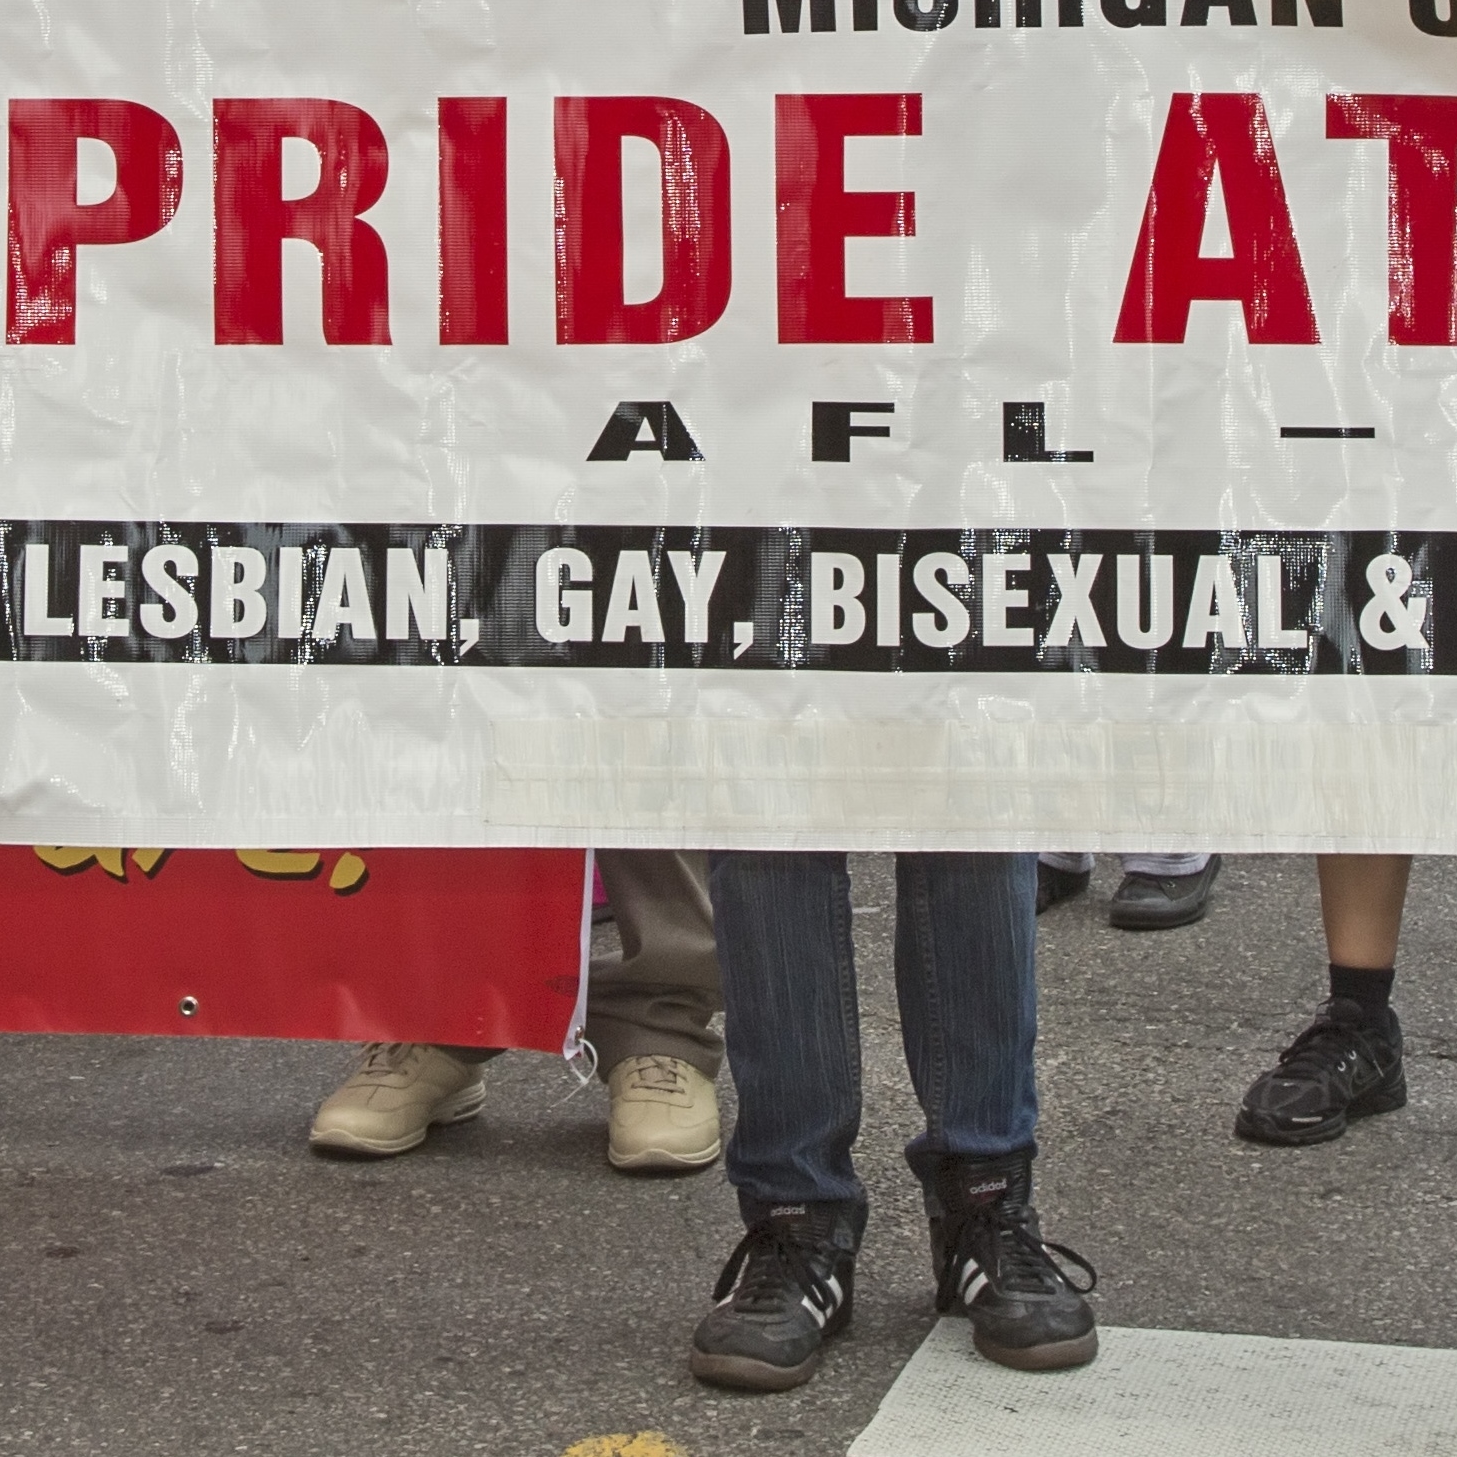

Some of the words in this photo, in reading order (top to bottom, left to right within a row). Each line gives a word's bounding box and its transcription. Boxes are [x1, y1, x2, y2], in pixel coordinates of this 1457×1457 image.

[6, 93, 934, 346] PRIDE
[22, 542, 479, 658] LESBIAN,
[534, 546, 753, 660] GAY,
[810, 549, 1310, 652] BISEXUAL
[1360, 552, 1432, 650] &
